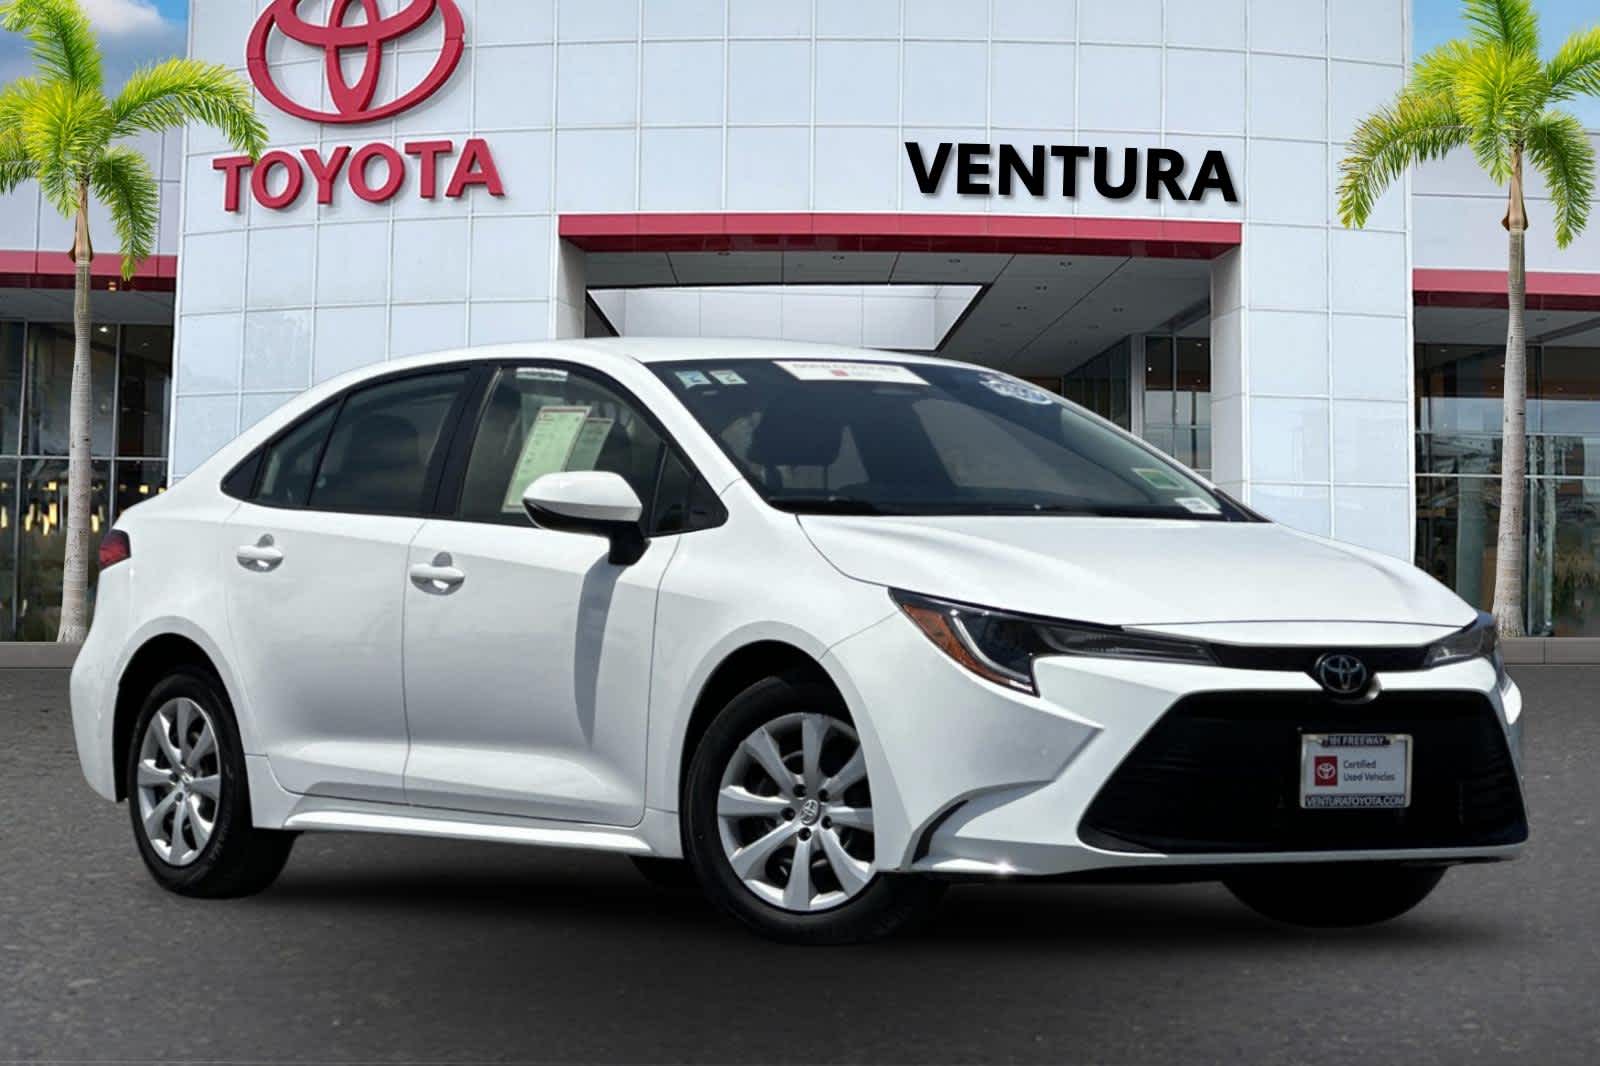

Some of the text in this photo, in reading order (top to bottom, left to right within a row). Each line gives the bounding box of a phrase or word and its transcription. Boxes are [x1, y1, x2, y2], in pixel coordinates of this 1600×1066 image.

[213, 139, 504, 212] TOYOTA
[904, 142, 1238, 202] VENTURA
[1342, 735, 1384, 745] FREEWAY
[1343, 760, 1377, 769] Certified
[1343, 772, 1396, 782] Used Vehicles
[1306, 796, 1404, 807] VENTURATOYOTA.COM
